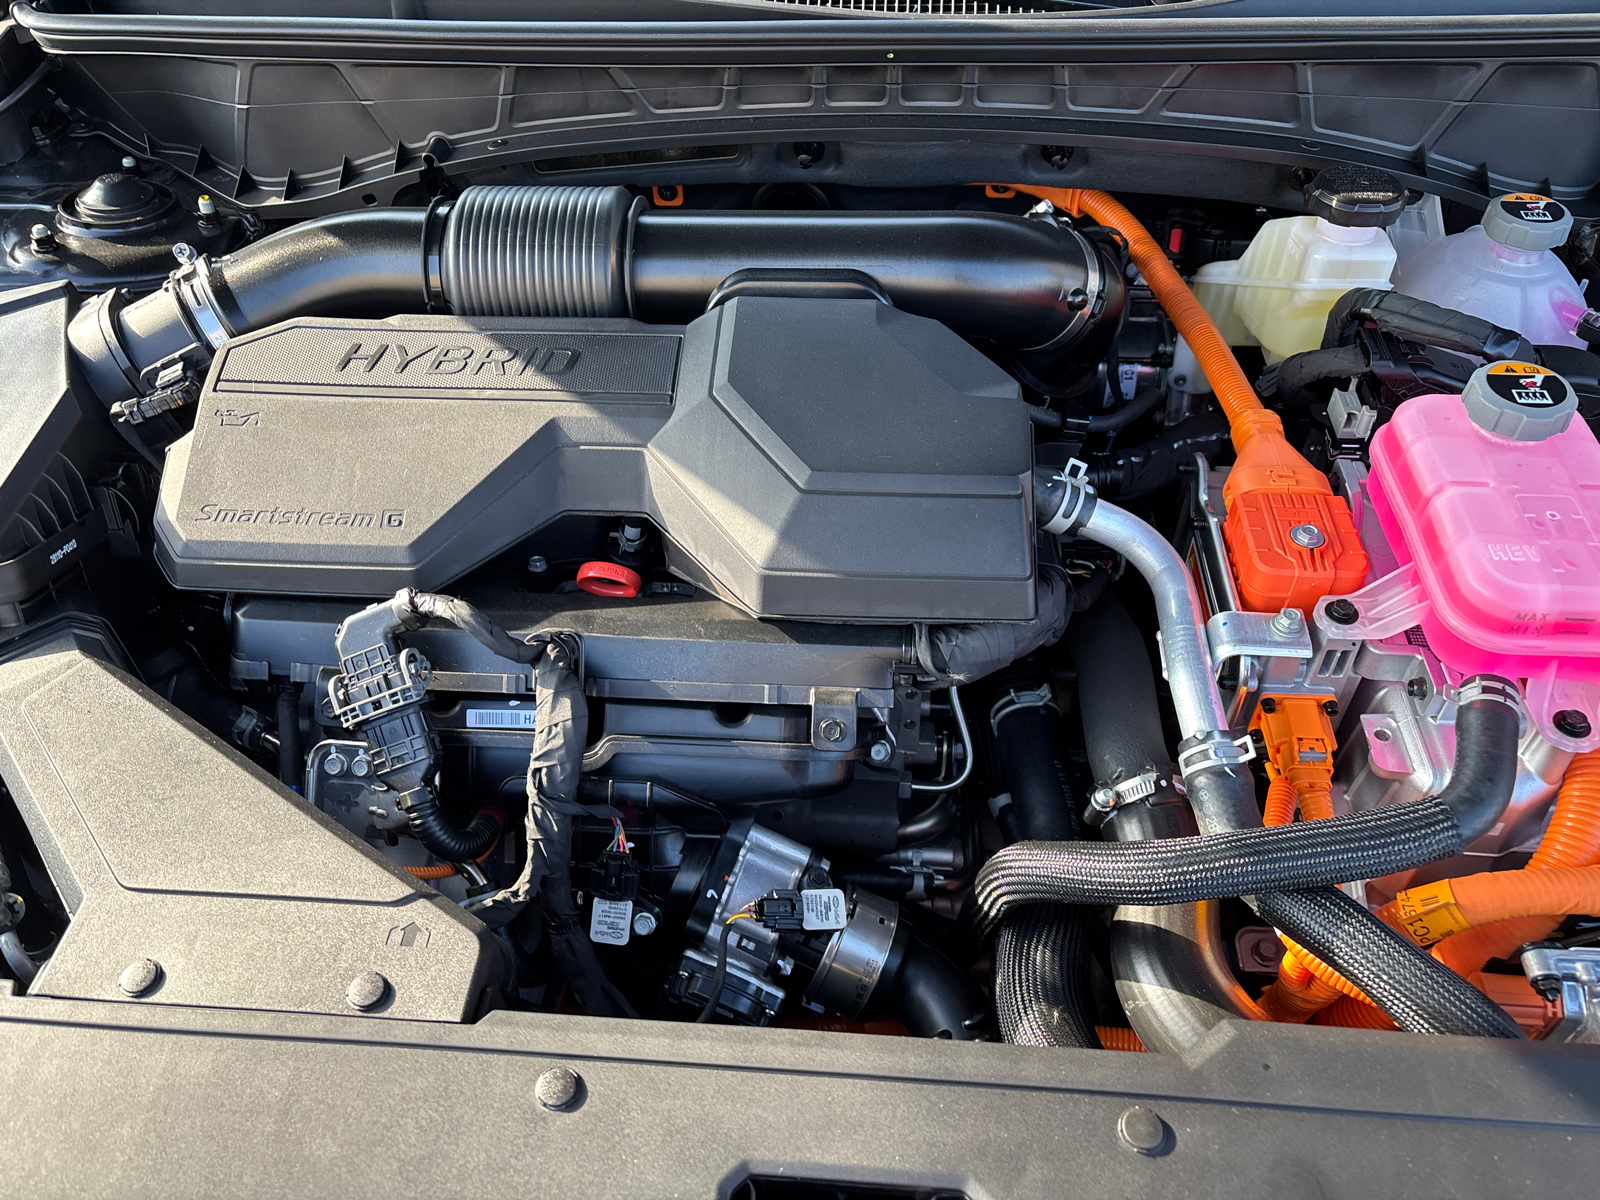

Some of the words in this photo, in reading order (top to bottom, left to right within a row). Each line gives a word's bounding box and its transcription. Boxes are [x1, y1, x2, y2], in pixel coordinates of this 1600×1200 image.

[335, 342, 582, 377] HYBRID
[194, 503, 376, 529] Smartstream
[1487, 543, 1541, 562] HEV
[597, 566, 626, 577] ENGINE
[1514, 612, 1550, 621] MAX
[1508, 626, 1543, 634] MIN
